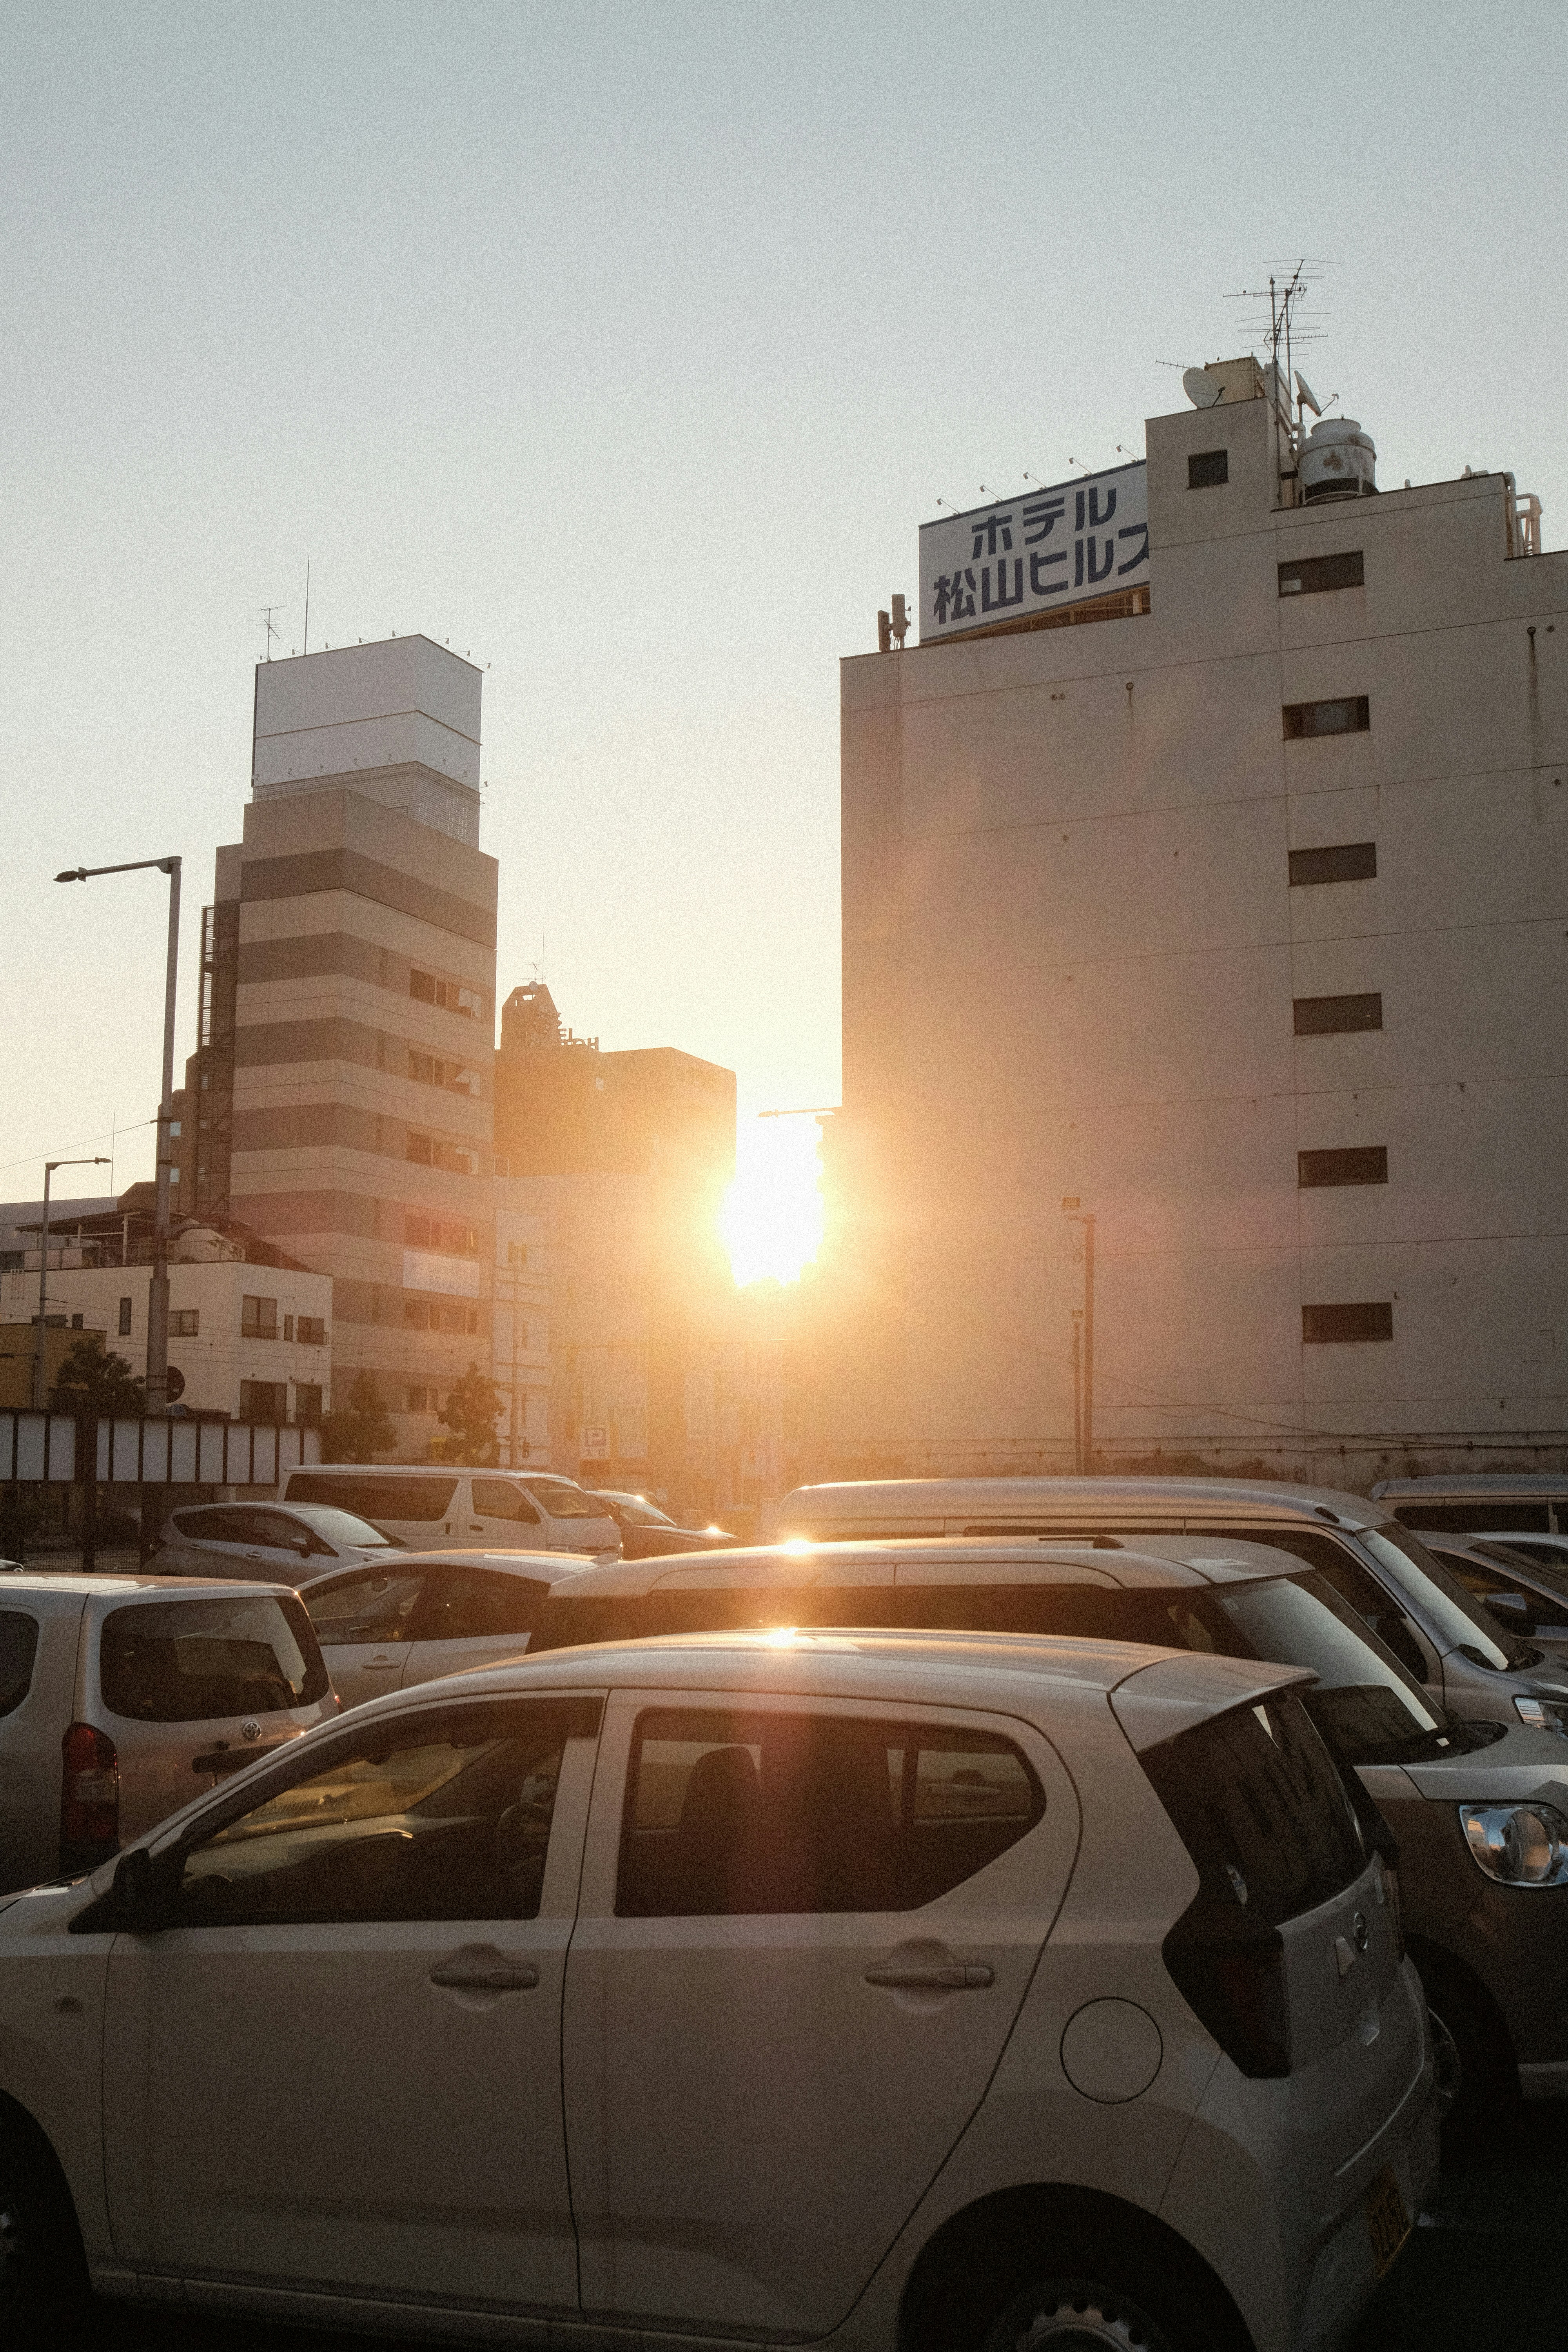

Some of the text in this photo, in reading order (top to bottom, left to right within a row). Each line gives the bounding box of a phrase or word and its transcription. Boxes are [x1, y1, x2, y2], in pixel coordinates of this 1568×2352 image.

[971, 486, 1116, 560] ホテル
[587, 1429, 603, 1445] P
